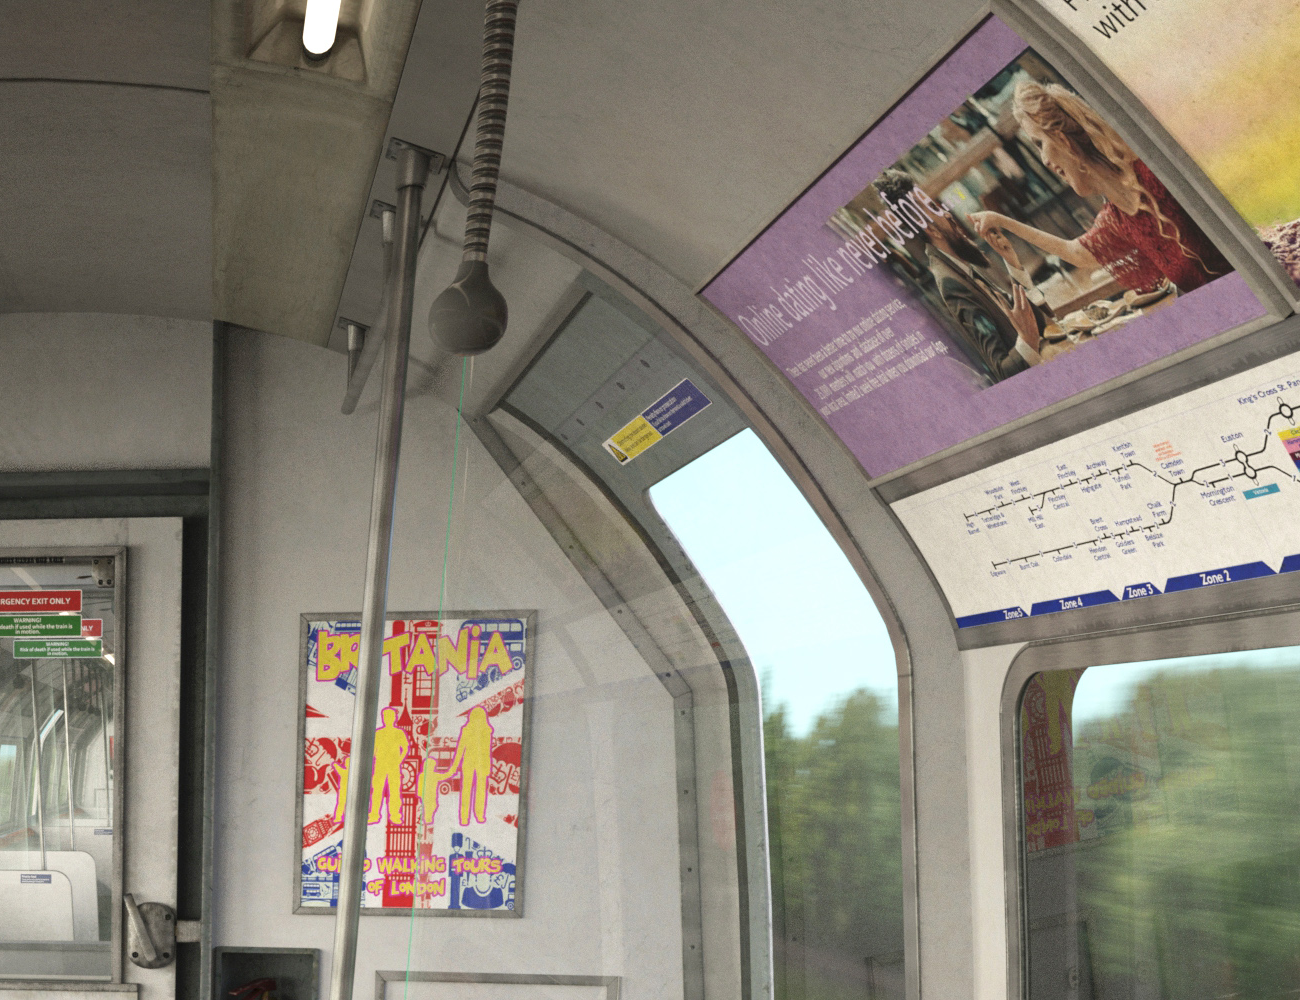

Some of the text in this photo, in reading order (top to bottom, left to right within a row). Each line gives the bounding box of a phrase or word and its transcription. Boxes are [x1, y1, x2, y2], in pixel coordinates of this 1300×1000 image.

[836, 224, 891, 276] never
[802, 254, 853, 295] like
[770, 275, 837, 322] dating
[738, 304, 793, 346] Online
[1237, 394, 1258, 405] King's
[1257, 388, 1278, 398] Cross
[1220, 432, 1244, 443] Euston
[1111, 442, 1133, 452] Kentish
[1120, 450, 1136, 459] Town
[1160, 458, 1184, 470] Camden
[1168, 468, 1186, 478] Town
[1200, 486, 1235, 499] Mornington
[1209, 494, 1237, 506] Crescent
[1200, 570, 1232, 586] Zone 2
[1126, 584, 1154, 599] Zone 3
[31, 597, 48, 605] EXIT
[49, 597, 71, 605] ONLY
[366, 878, 446, 897] OF LONDON
